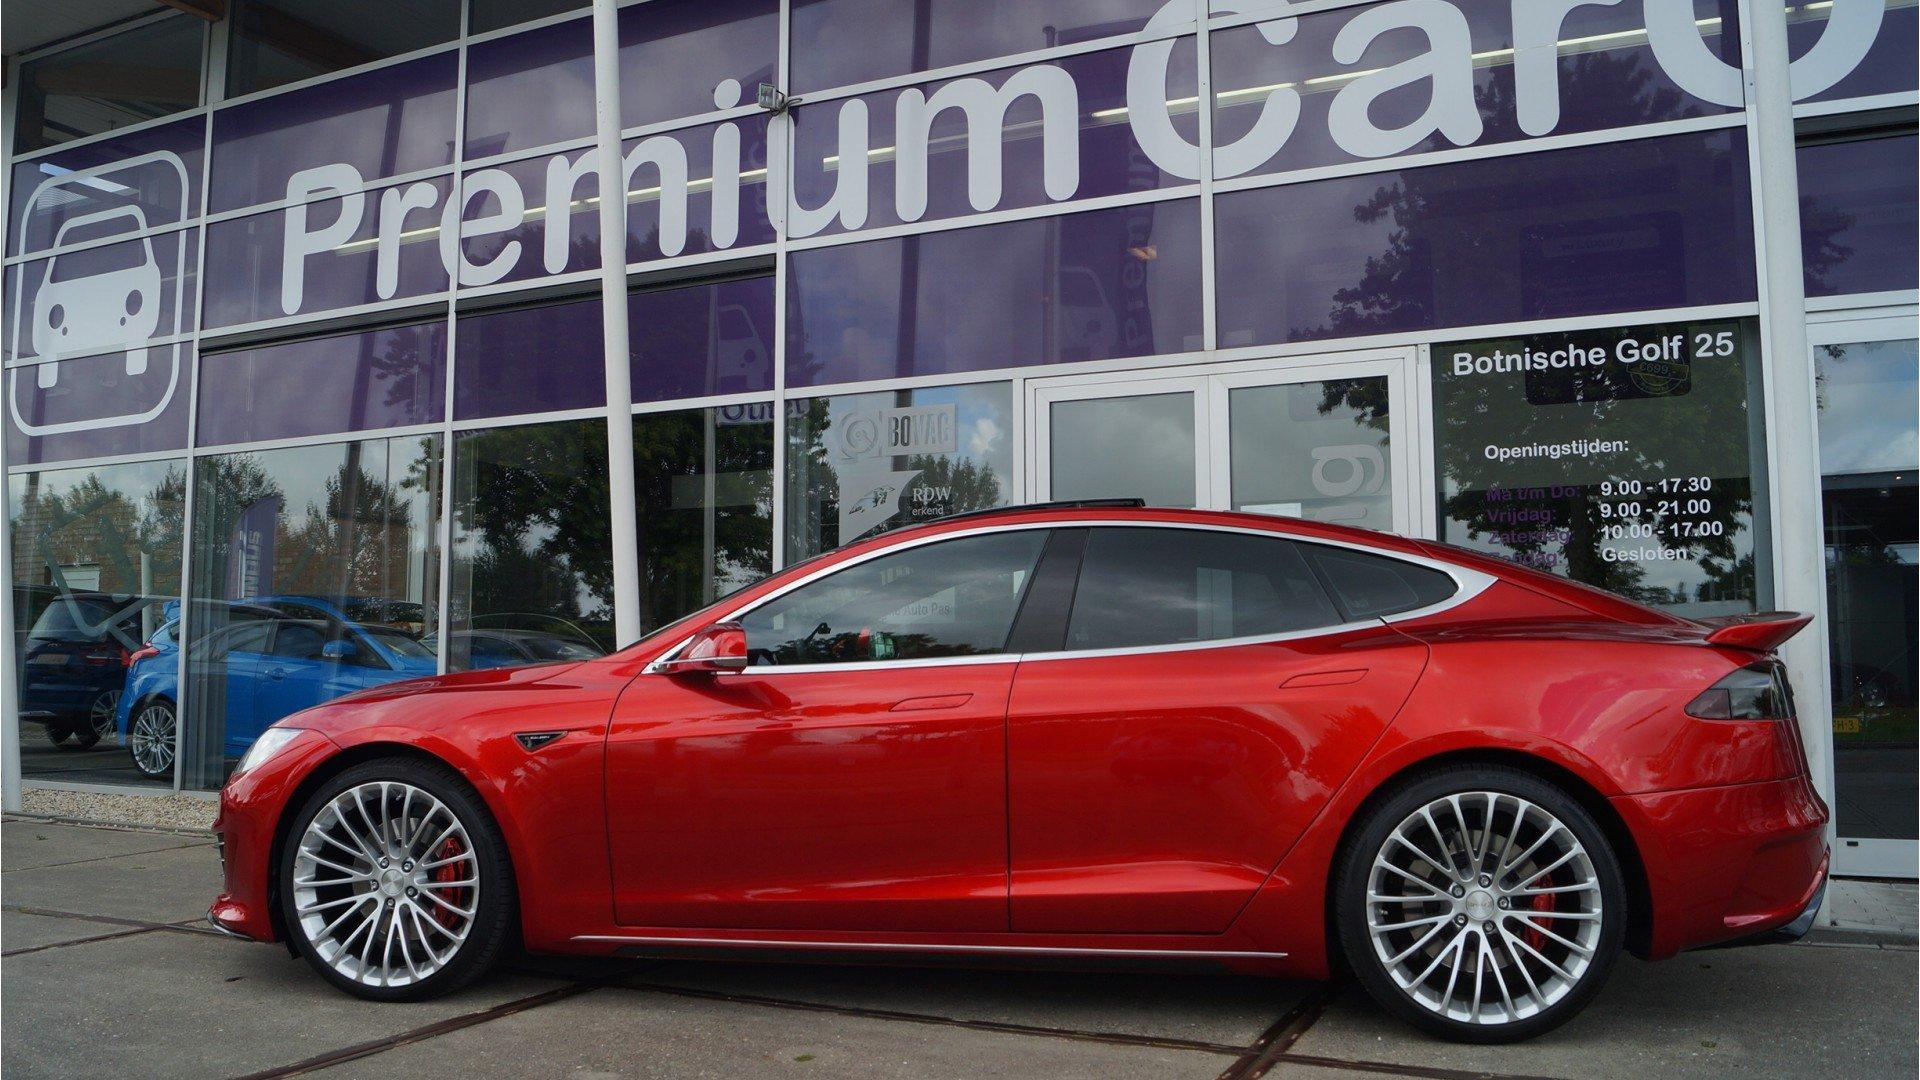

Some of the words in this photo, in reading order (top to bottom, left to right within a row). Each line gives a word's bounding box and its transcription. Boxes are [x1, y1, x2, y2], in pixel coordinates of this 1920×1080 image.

[1453, 343, 1606, 376] Botnische
[1615, 334, 1683, 364] Golf
[1695, 331, 1734, 358] 25
[887, 412, 949, 447] BOVAG
[1485, 438, 1629, 462] Openingstijden:
[1600, 480, 1641, 496] 9.00
[1658, 476, 1712, 493] 17.30
[912, 505, 944, 516] erkend
[1487, 508, 1557, 526] Vrijdag:
[1600, 502, 1641, 518] 9.00
[1657, 498, 1711, 516] 21.00
[1601, 523, 1653, 540] 10.00
[1669, 520, 1723, 538] 17.00
[1602, 546, 1688, 562] Gesloten
